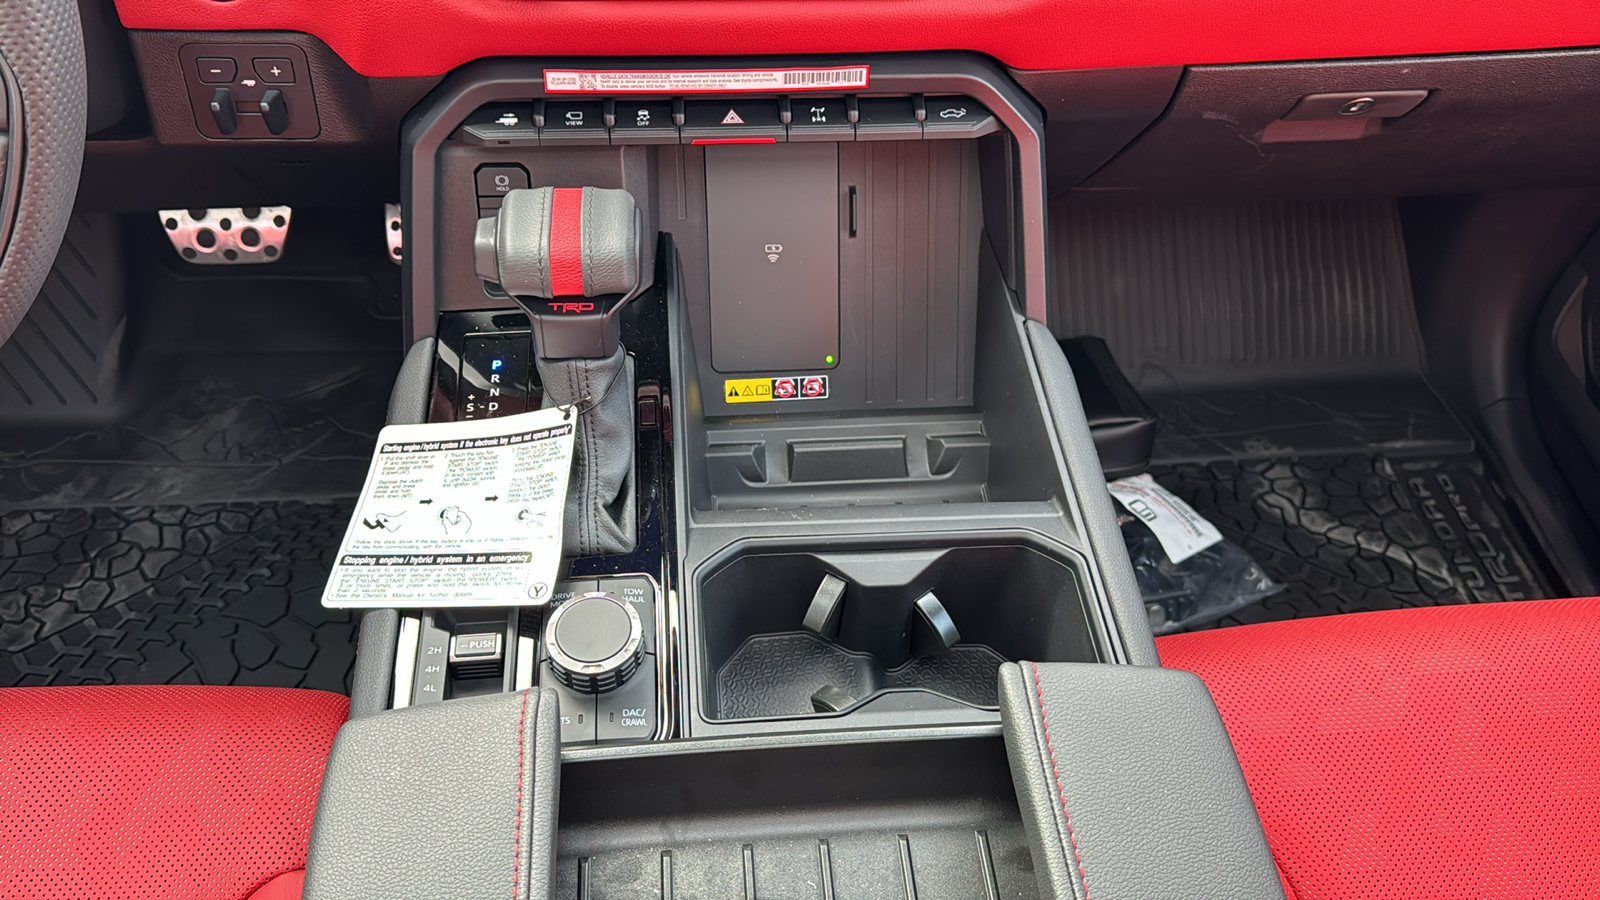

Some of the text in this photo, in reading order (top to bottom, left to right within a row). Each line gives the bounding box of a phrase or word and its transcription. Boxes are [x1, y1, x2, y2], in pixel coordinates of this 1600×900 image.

[548, 302, 594, 313] TRD
[492, 360, 502, 370] P
[491, 374, 500, 382] R
[490, 388, 500, 397] N
[466, 402, 498, 412] S D
[383, 444, 402, 452] Starting
[441, 442, 458, 450] system
[475, 438, 498, 447] electronic
[500, 437, 508, 446] key
[533, 430, 549, 440] operate
[343, 556, 376, 565] Stopping
[436, 555, 462, 565] system
[489, 554, 531, 563] emergency
[534, 586, 544, 597] Y
[551, 592, 576, 600] DRIVE
[470, 640, 494, 649] PUSH
[427, 646, 442, 655] 2H
[622, 708, 646, 717] DAC/
